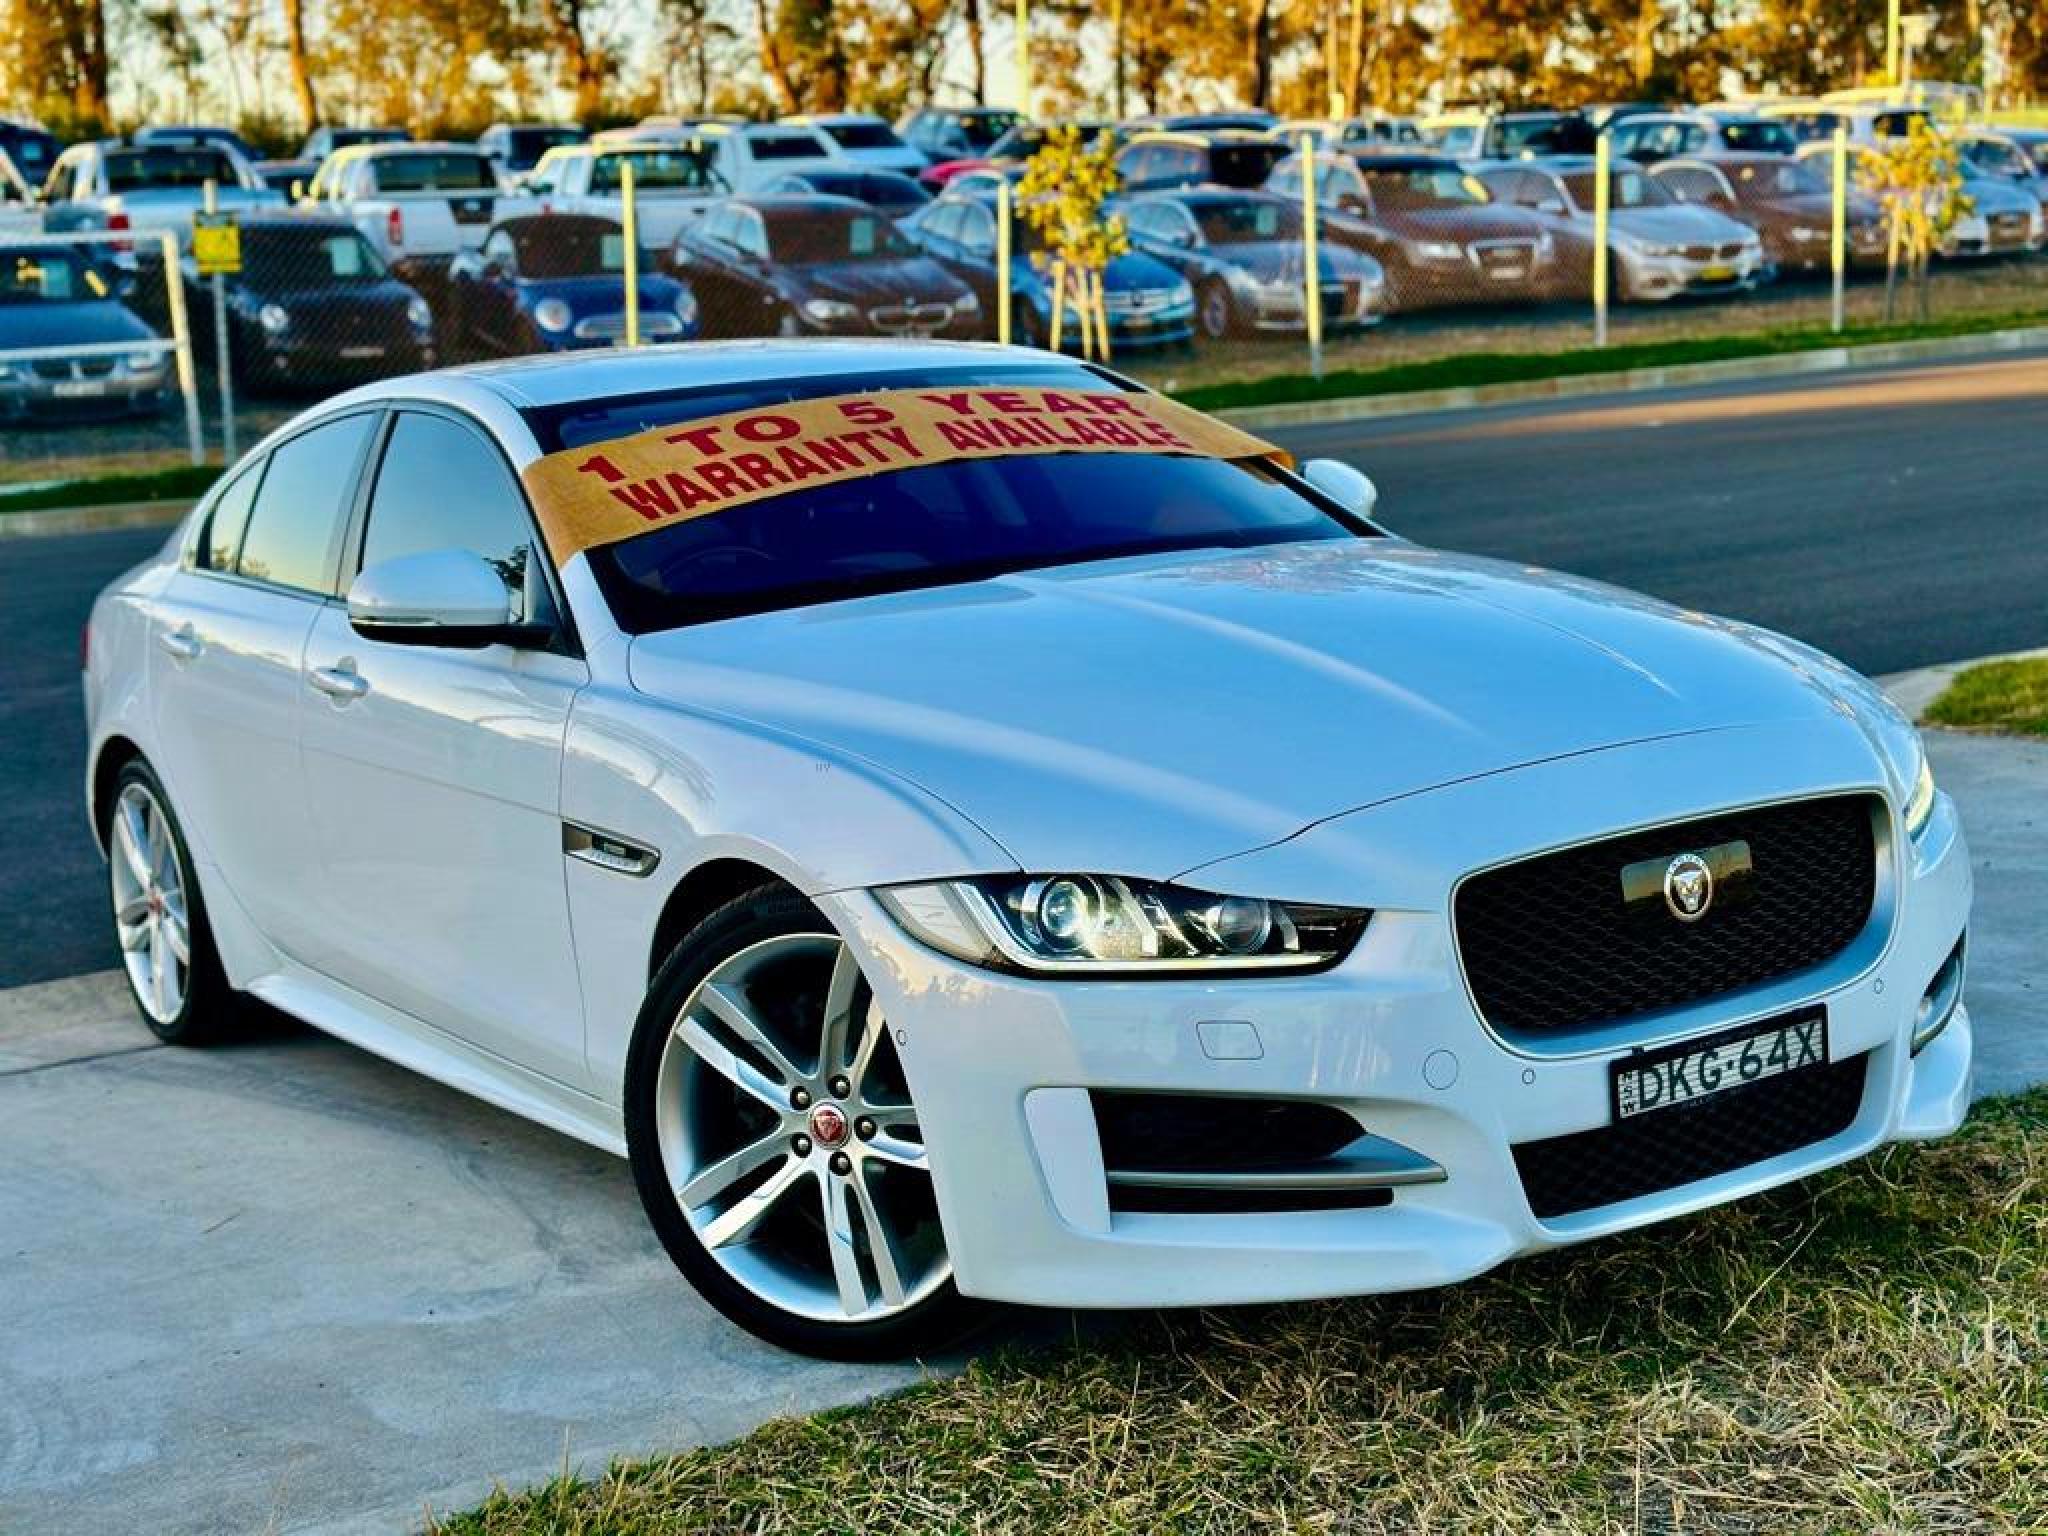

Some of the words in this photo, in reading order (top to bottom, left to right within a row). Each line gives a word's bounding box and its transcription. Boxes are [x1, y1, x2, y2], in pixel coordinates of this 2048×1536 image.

[577, 455, 627, 482] 1
[664, 415, 801, 456] TO
[837, 401, 895, 424] 5
[916, 392, 1145, 417] YEAR
[609, 427, 924, 520] WARRANTY
[934, 417, 1193, 450] AVAILABLE
